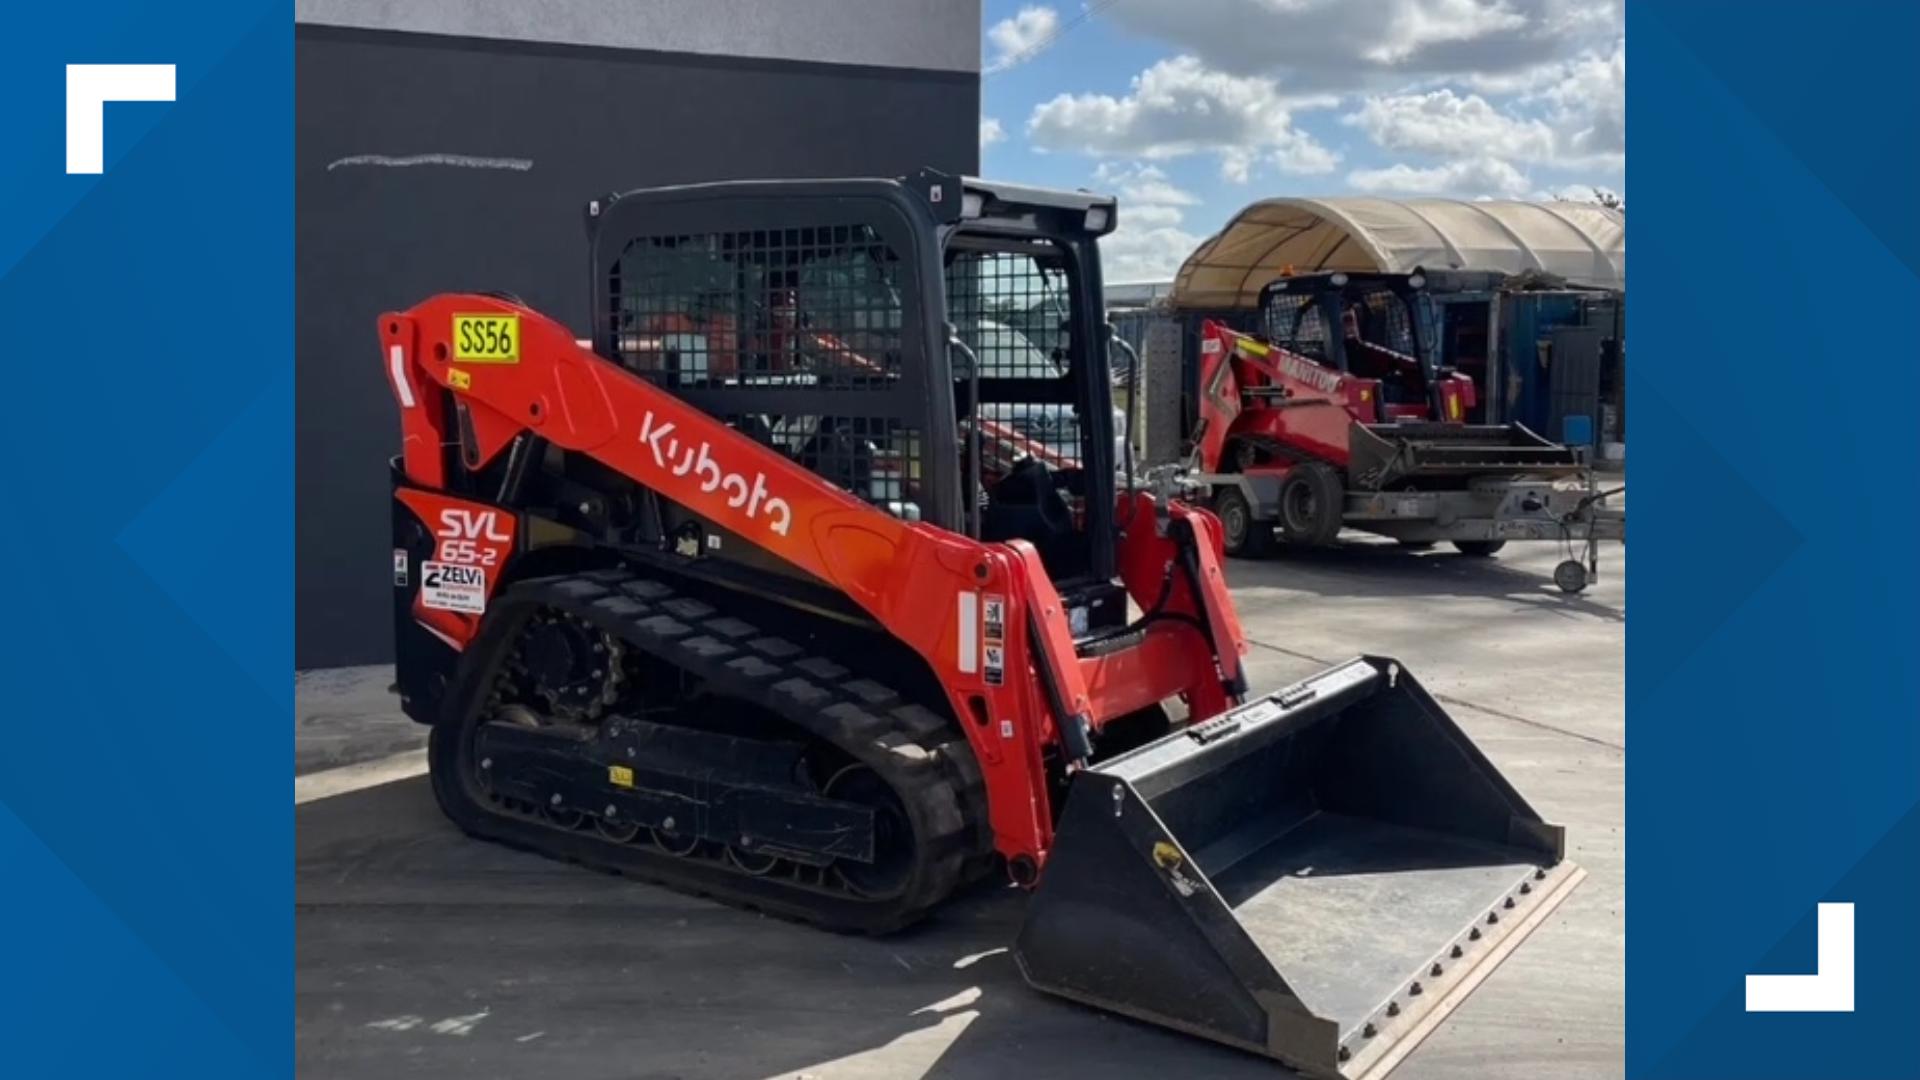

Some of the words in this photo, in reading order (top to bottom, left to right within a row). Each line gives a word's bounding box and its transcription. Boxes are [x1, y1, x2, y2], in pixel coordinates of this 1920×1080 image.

[460, 319, 512, 355] SS56
[639, 410, 791, 537] Kubota
[437, 508, 510, 541] SVL
[440, 540, 497, 566] 65-2
